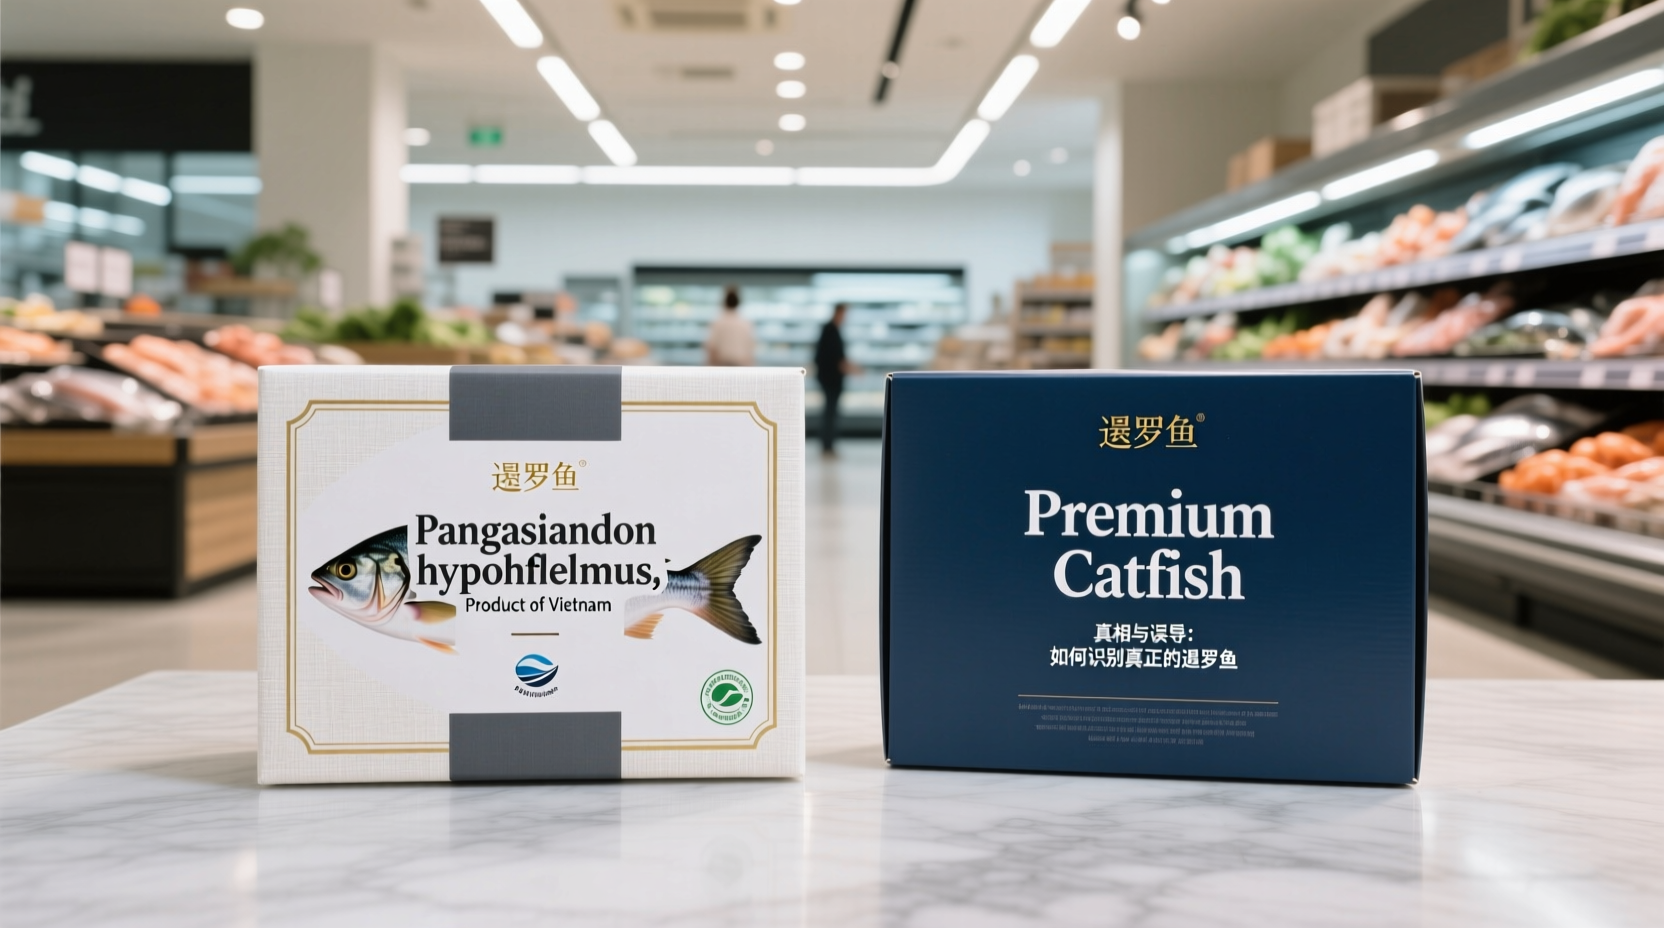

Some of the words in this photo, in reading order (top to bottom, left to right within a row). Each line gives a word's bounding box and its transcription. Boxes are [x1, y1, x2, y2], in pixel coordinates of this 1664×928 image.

[415, 512, 657, 556] Pangasiandon
[1024, 488, 1275, 539] Premium
[1053, 548, 1246, 600] Catfish
[465, 596, 526, 613] Product
[530, 596, 546, 613] of
[548, 597, 612, 613] Vietnam
